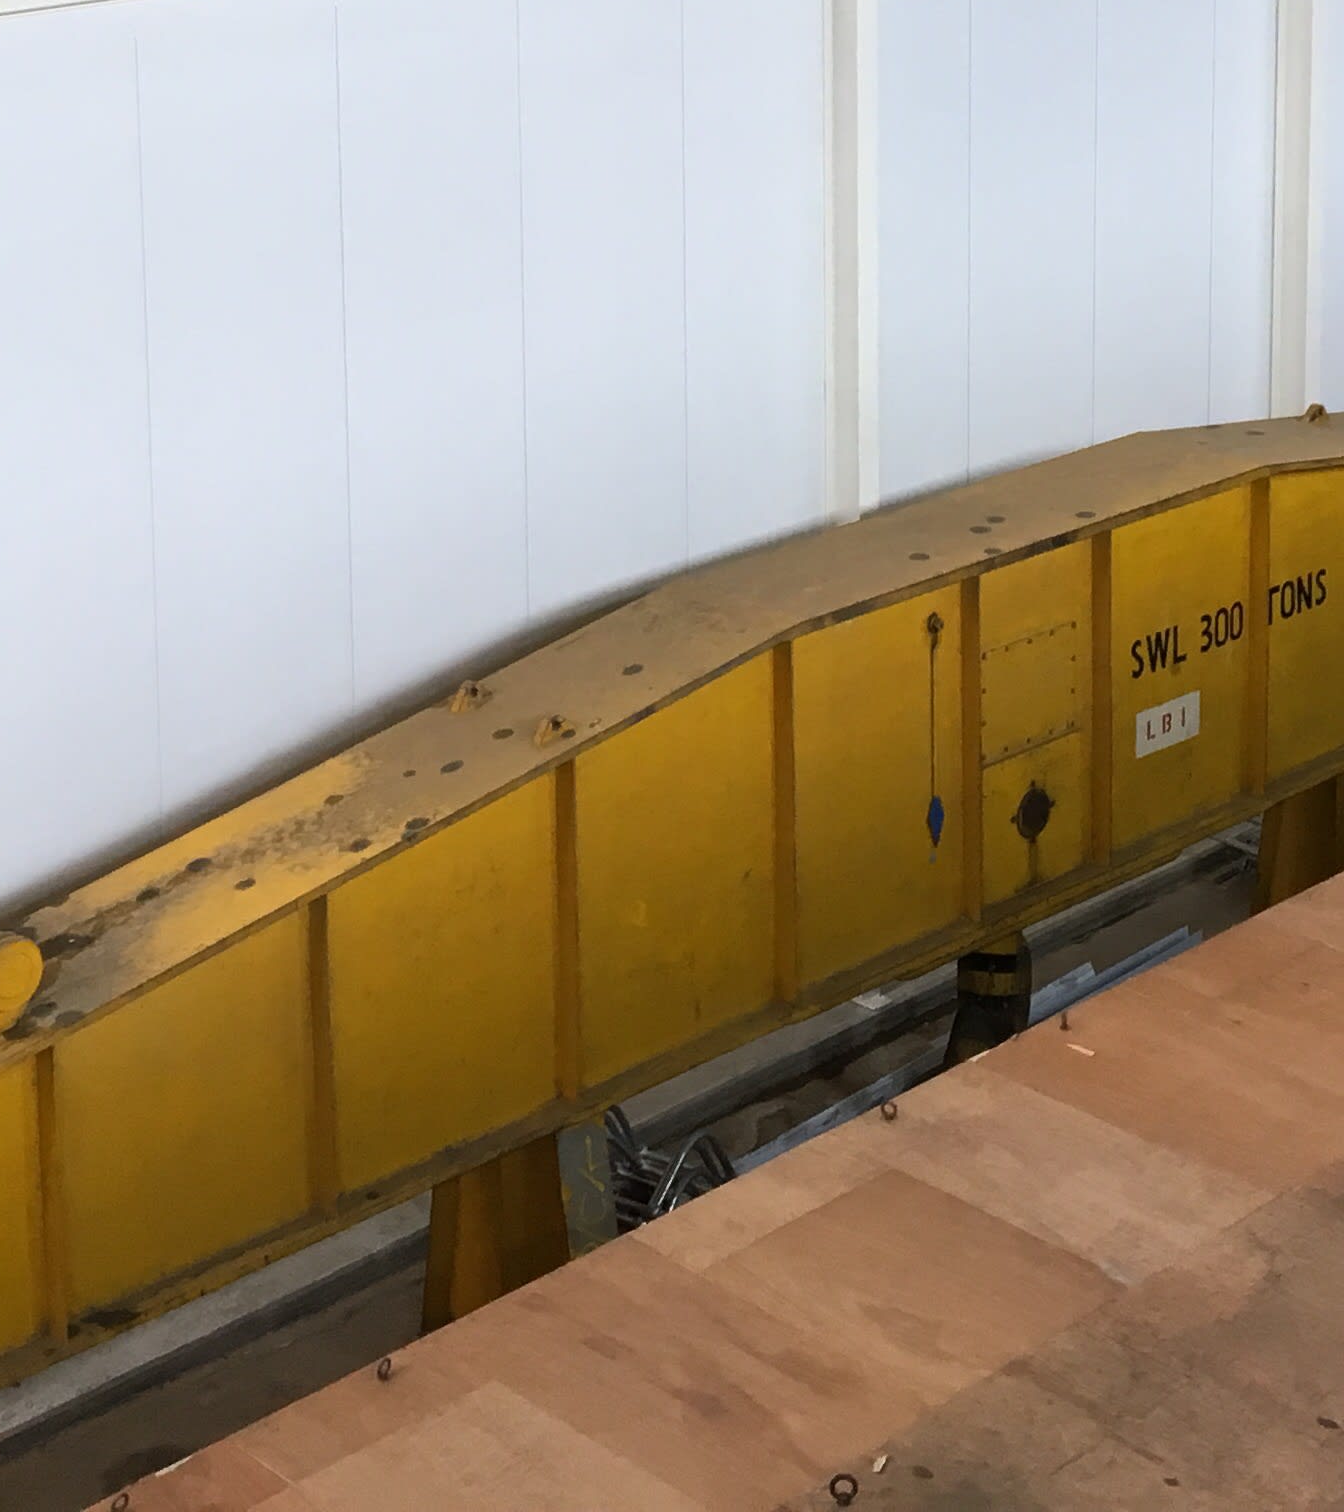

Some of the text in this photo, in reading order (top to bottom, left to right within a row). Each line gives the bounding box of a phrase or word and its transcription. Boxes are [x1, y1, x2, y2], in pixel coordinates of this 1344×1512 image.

[1131, 568, 1327, 679] SWL 300 TONS
